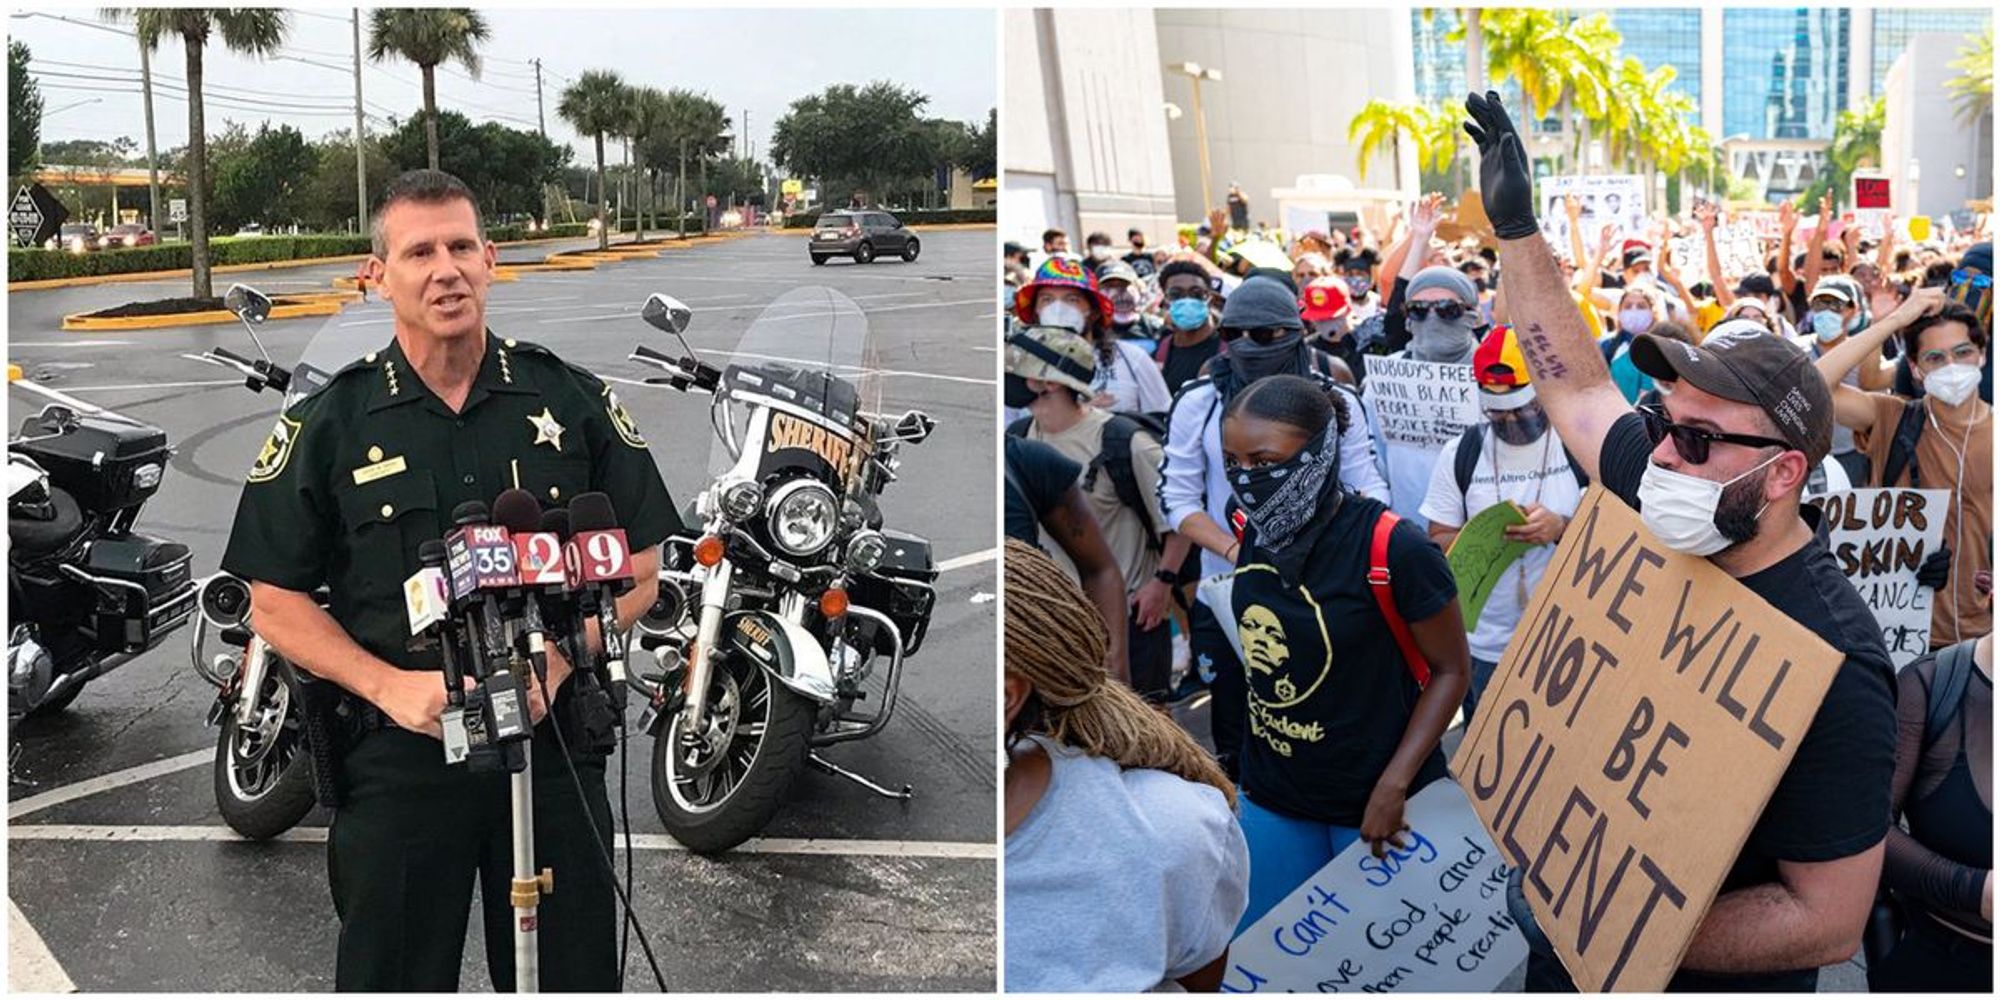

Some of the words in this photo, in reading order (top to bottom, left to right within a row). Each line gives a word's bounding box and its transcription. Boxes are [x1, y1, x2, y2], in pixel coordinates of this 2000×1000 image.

[1368, 359, 1434, 380] NOBODY'S
[1371, 381, 1410, 399] UNTIL
[1417, 384, 1471, 403] BLACK
[1375, 398, 1421, 416] PEOPLE
[1430, 404, 1458, 420] SEE
[768, 412, 852, 485] SHERIFF
[474, 526, 504, 543] FOX
[588, 533, 624, 576] 9
[476, 546, 511, 573] 35
[528, 532, 565, 583] 2
[565, 542, 582, 587] 9
[1836, 537, 1924, 579] SKIN
[1858, 582, 1927, 610] ANCE
[737, 616, 770, 647] SHERIFF
[1572, 506, 1667, 634] WE
[1659, 579, 1792, 751] WILL
[1519, 604, 1619, 728] NOT
[1603, 696, 1690, 820] BE
[1440, 836, 1486, 892] and
[1473, 699, 1687, 993] SILENT
[1416, 907, 1471, 965] people
[1480, 863, 1512, 900] are
